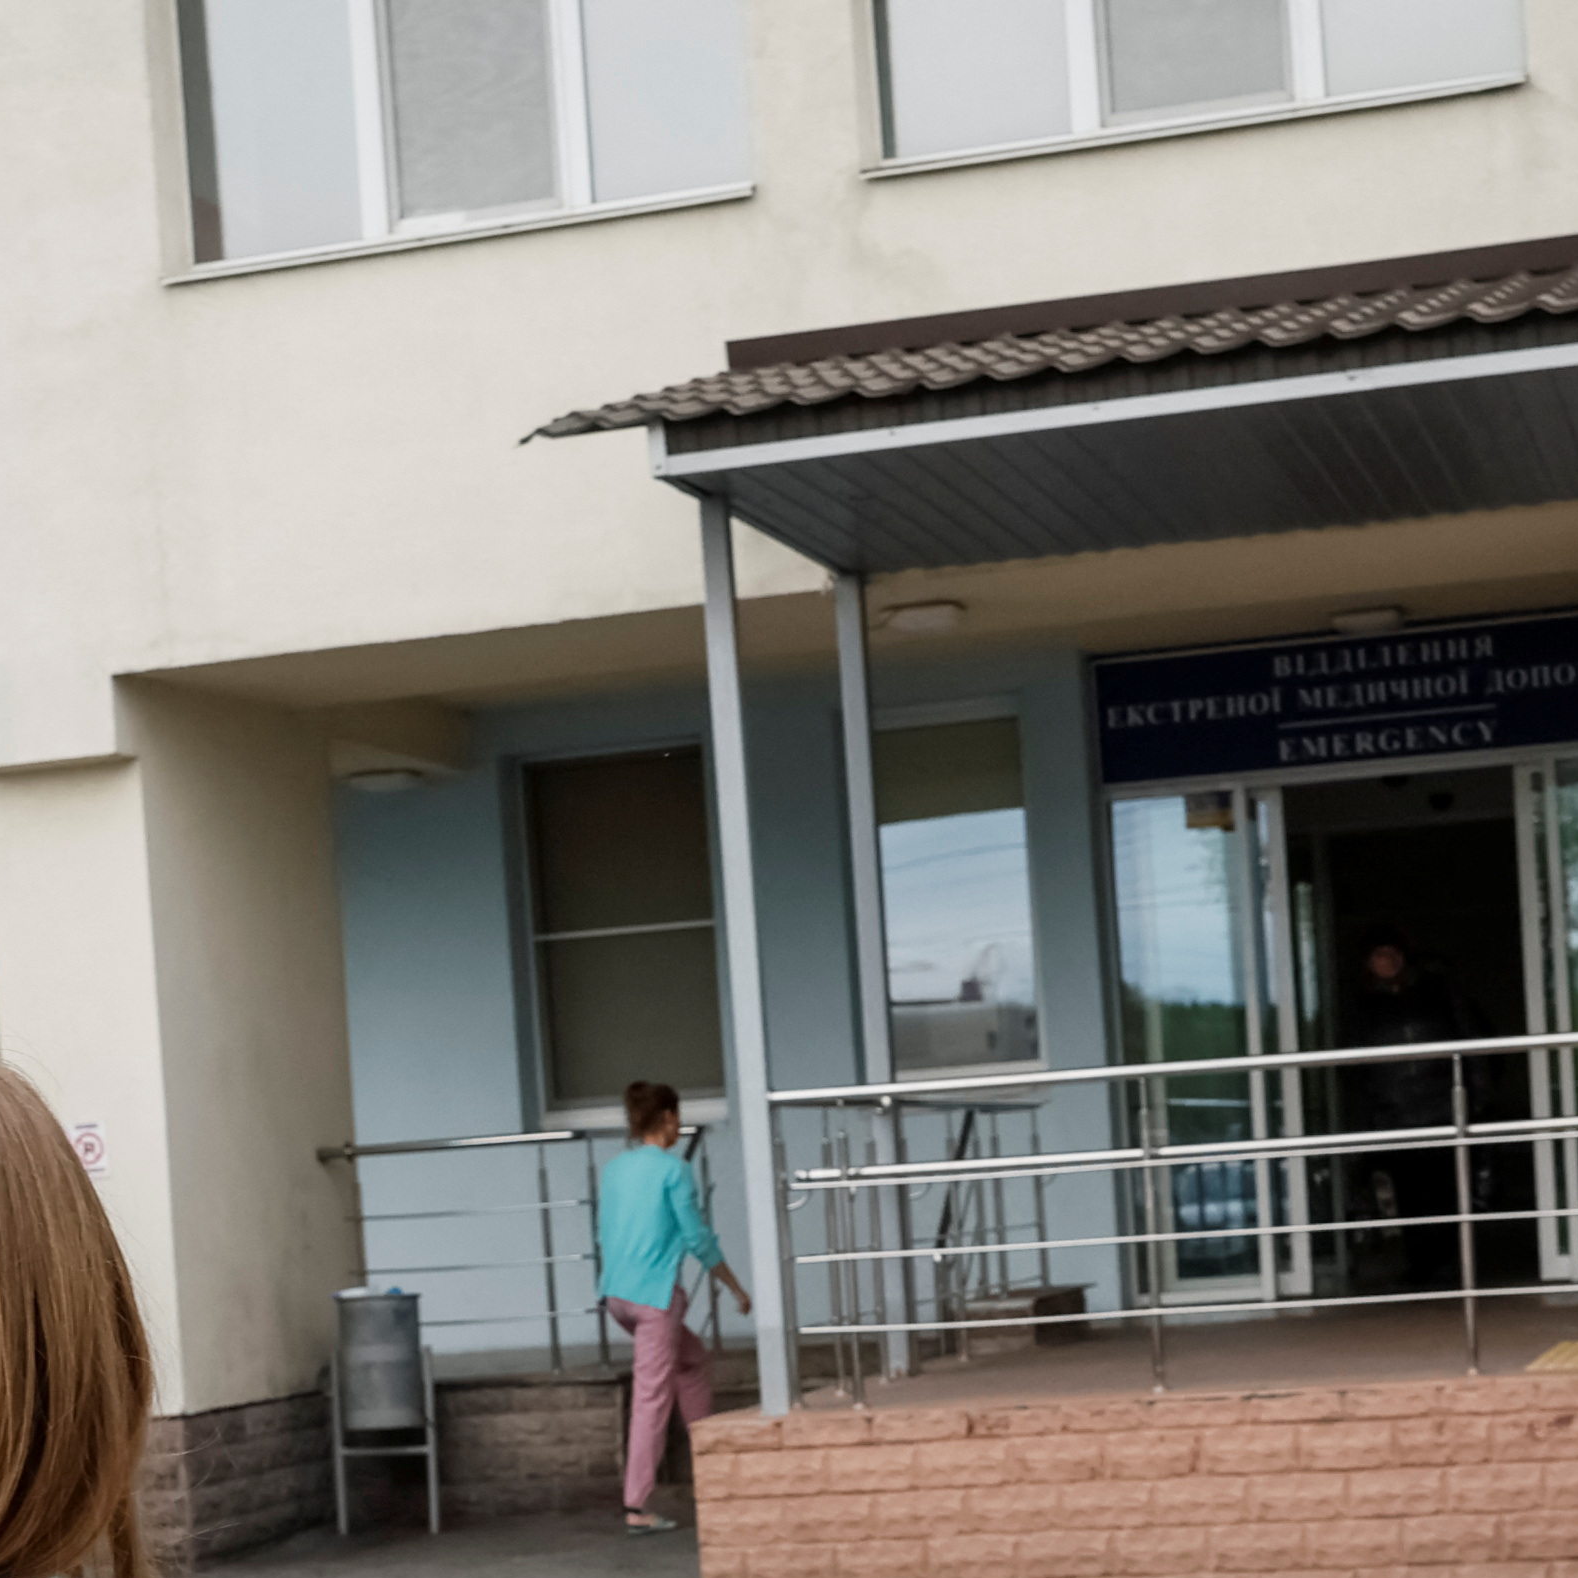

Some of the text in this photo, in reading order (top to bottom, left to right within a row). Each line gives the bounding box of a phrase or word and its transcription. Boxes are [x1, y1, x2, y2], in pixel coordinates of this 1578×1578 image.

[1274, 634, 1494, 678] ВІДДІЛЕННЯ
[1106, 685, 1283, 729] ЕКСТРЕНОЇ
[1298, 667, 1469, 709] МЕДИЧНОЇ
[1278, 719, 1496, 761] EMERGENCY
